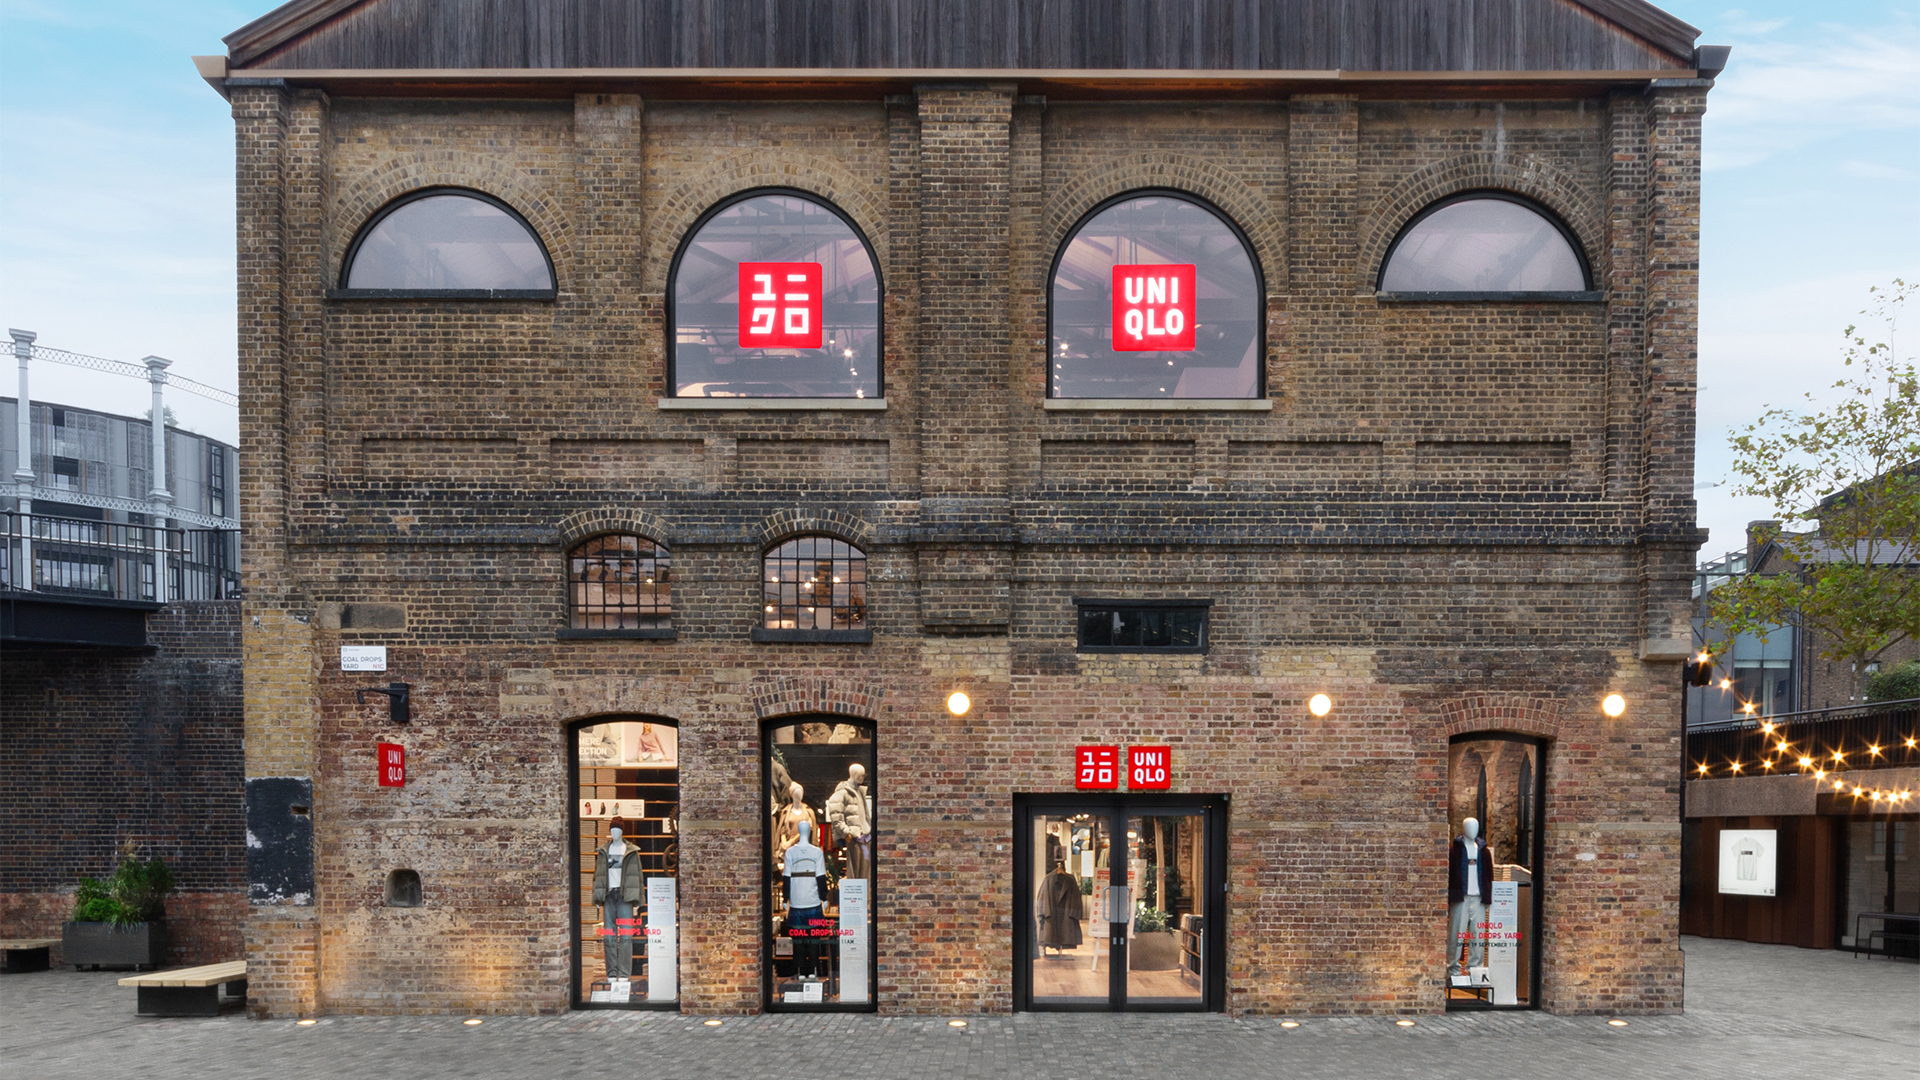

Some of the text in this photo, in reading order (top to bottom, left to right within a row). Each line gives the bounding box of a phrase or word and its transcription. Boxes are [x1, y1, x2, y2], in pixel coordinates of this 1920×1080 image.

[752, 274, 809, 301] ユニ
[1125, 277, 1178, 304] UNI
[750, 307, 809, 334] クロ
[1125, 308, 1184, 340] QLO
[388, 750, 401, 764] UNI
[1082, 752, 1112, 766] ユニ
[1134, 752, 1162, 766] UNI
[388, 766, 402, 782] QLO
[1081, 768, 1112, 783] クロ
[1134, 768, 1165, 785] QLO
[615, 918, 642, 926] UNIQLO
[808, 919, 835, 927] UNIQLO
[1477, 922, 1503, 930] UNIQLO
[596, 928, 662, 936] COAL DROPS YARD
[789, 929, 854, 937] COAL DROPS YARD
[1456, 931, 1523, 940] COAL DROPS YARD
